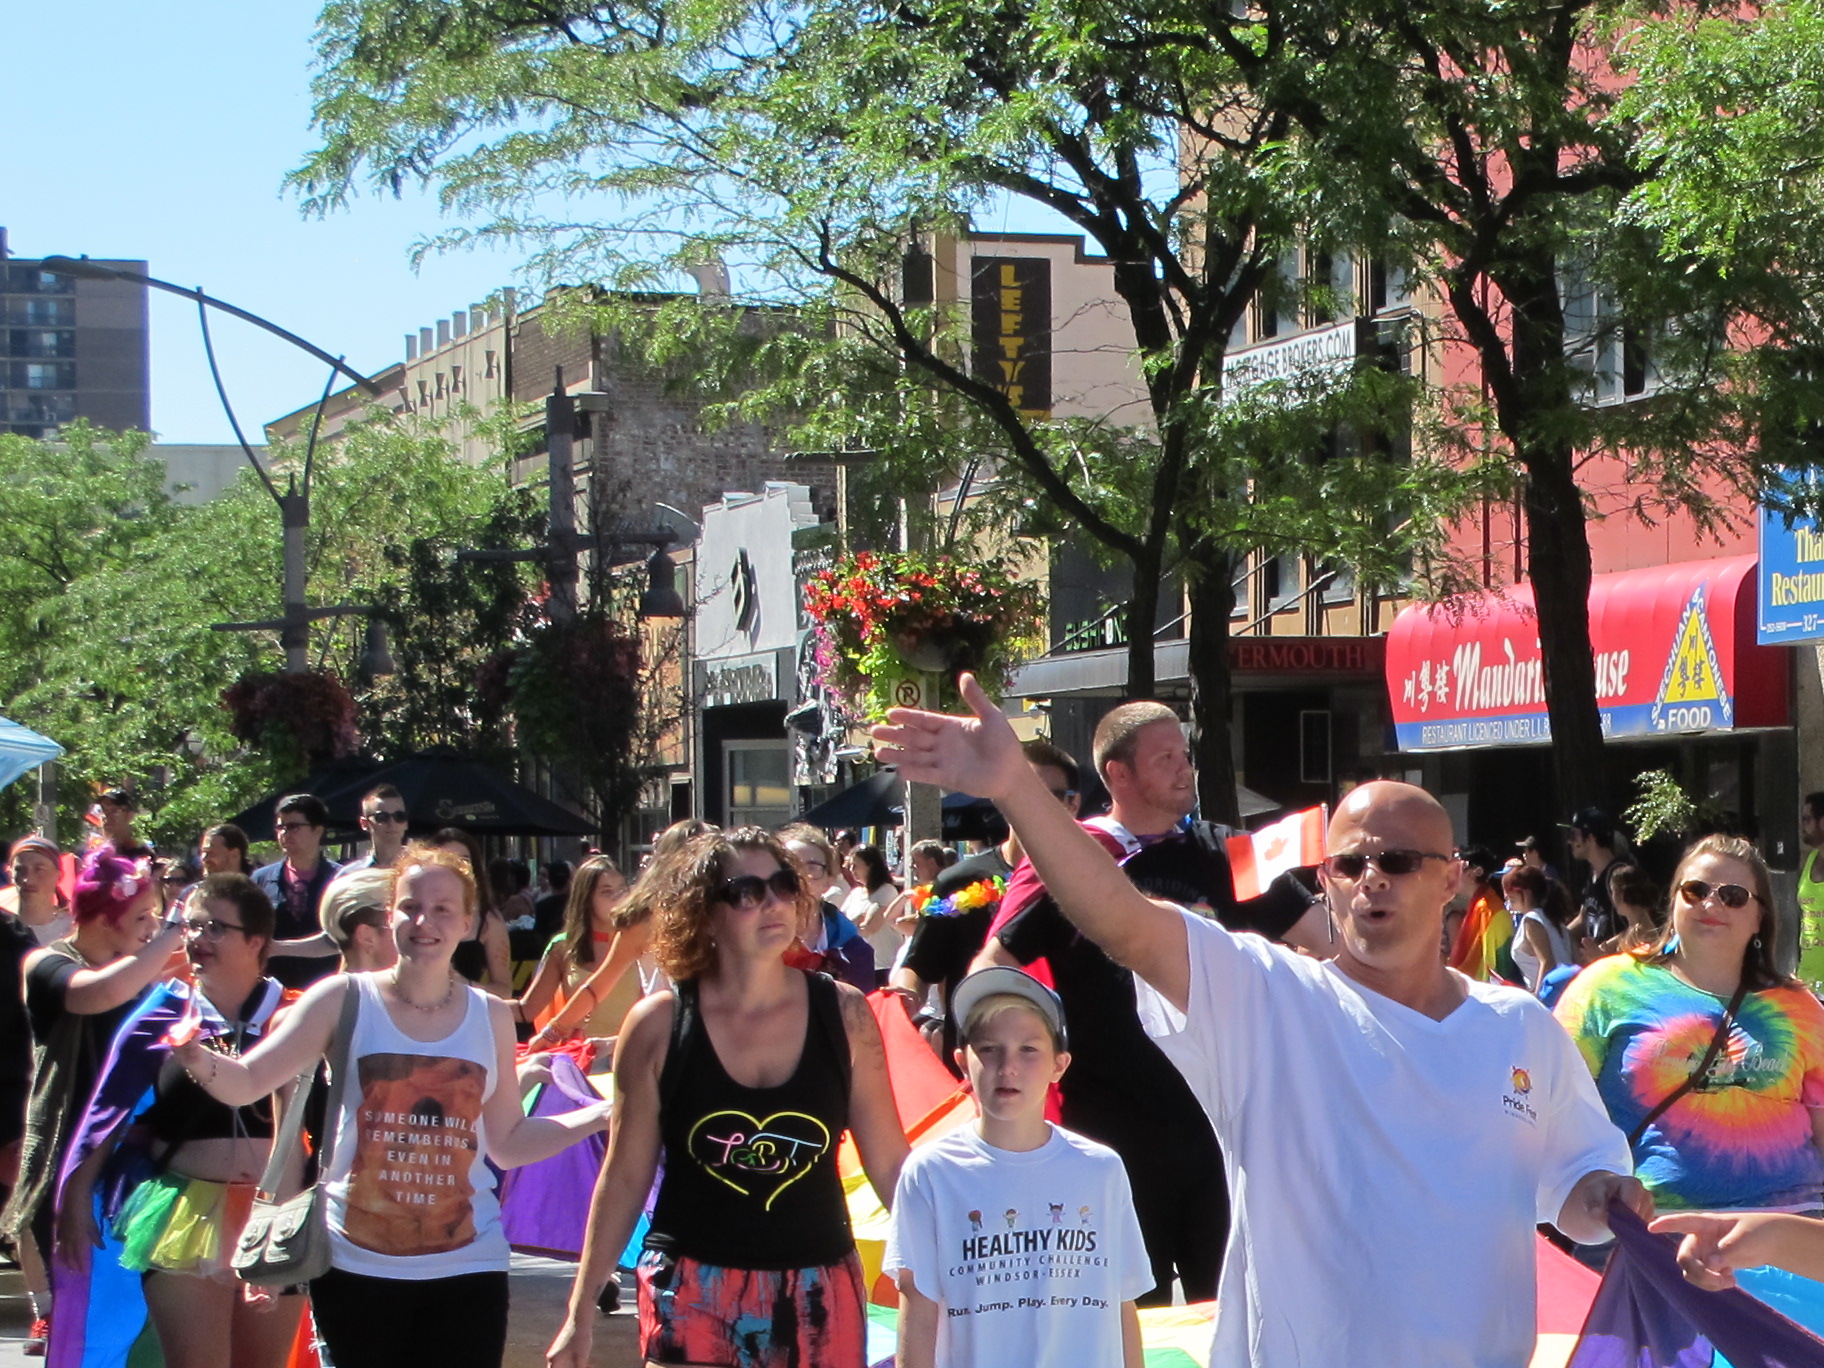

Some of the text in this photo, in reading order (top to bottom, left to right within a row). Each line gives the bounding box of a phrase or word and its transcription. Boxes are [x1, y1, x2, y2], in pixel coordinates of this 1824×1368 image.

[1802, 614, 1819, 633] 327
[1668, 707, 1712, 731] FOOD
[1422, 723, 1468, 745] RESTAURANT
[1502, 1095, 1525, 1113] Pride
[364, 1110, 477, 1133] SOMEONE WILL
[386, 1150, 452, 1166] EVEN IN
[378, 1169, 456, 1186] ANOTHER
[395, 1191, 437, 1205] TIME
[962, 1227, 1097, 1261] HEALTHY KIDS
[949, 1253, 1109, 1277] COMMUNITY CHALLENGE
[974, 1299, 1015, 1314] Jump.
[1018, 1297, 1046, 1309] Play.
[1050, 1296, 1079, 1308] Every
[1082, 1296, 1109, 1310] Day.
